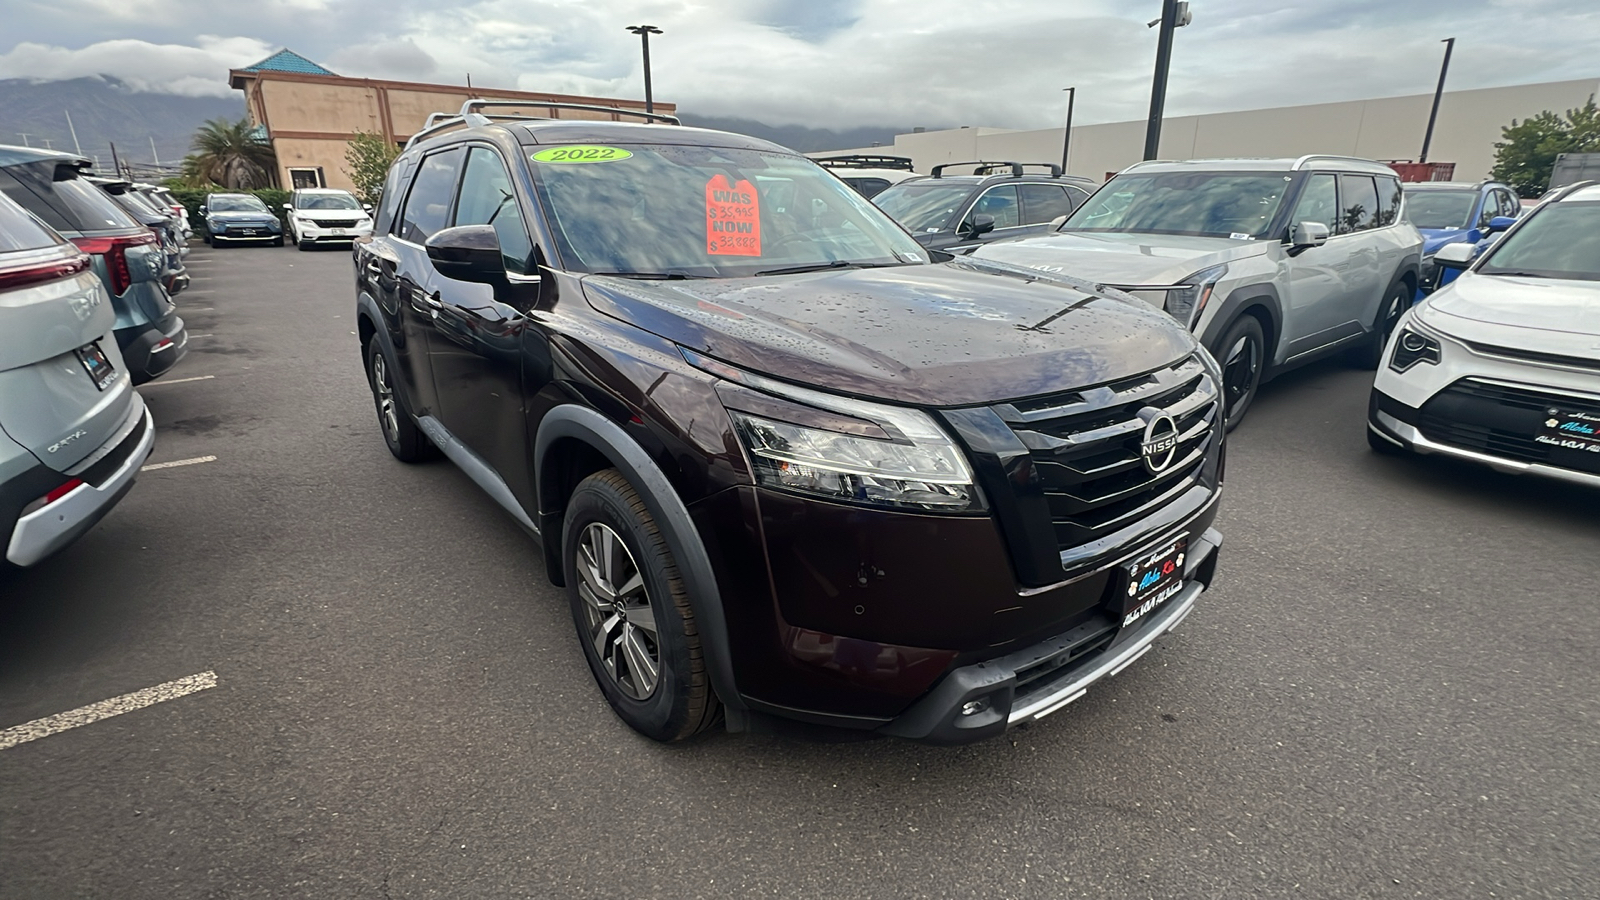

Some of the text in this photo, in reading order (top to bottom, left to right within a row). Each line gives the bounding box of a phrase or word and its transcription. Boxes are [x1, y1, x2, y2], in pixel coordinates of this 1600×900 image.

[551, 149, 615, 161] 2022
[713, 190, 751, 204] WAS
[713, 221, 753, 233] NOW
[1560, 422, 1594, 434] Aloha
[1142, 437, 1176, 456] NISSA
[1534, 436, 1560, 445] Aloha
[1138, 567, 1161, 592] Aloha
